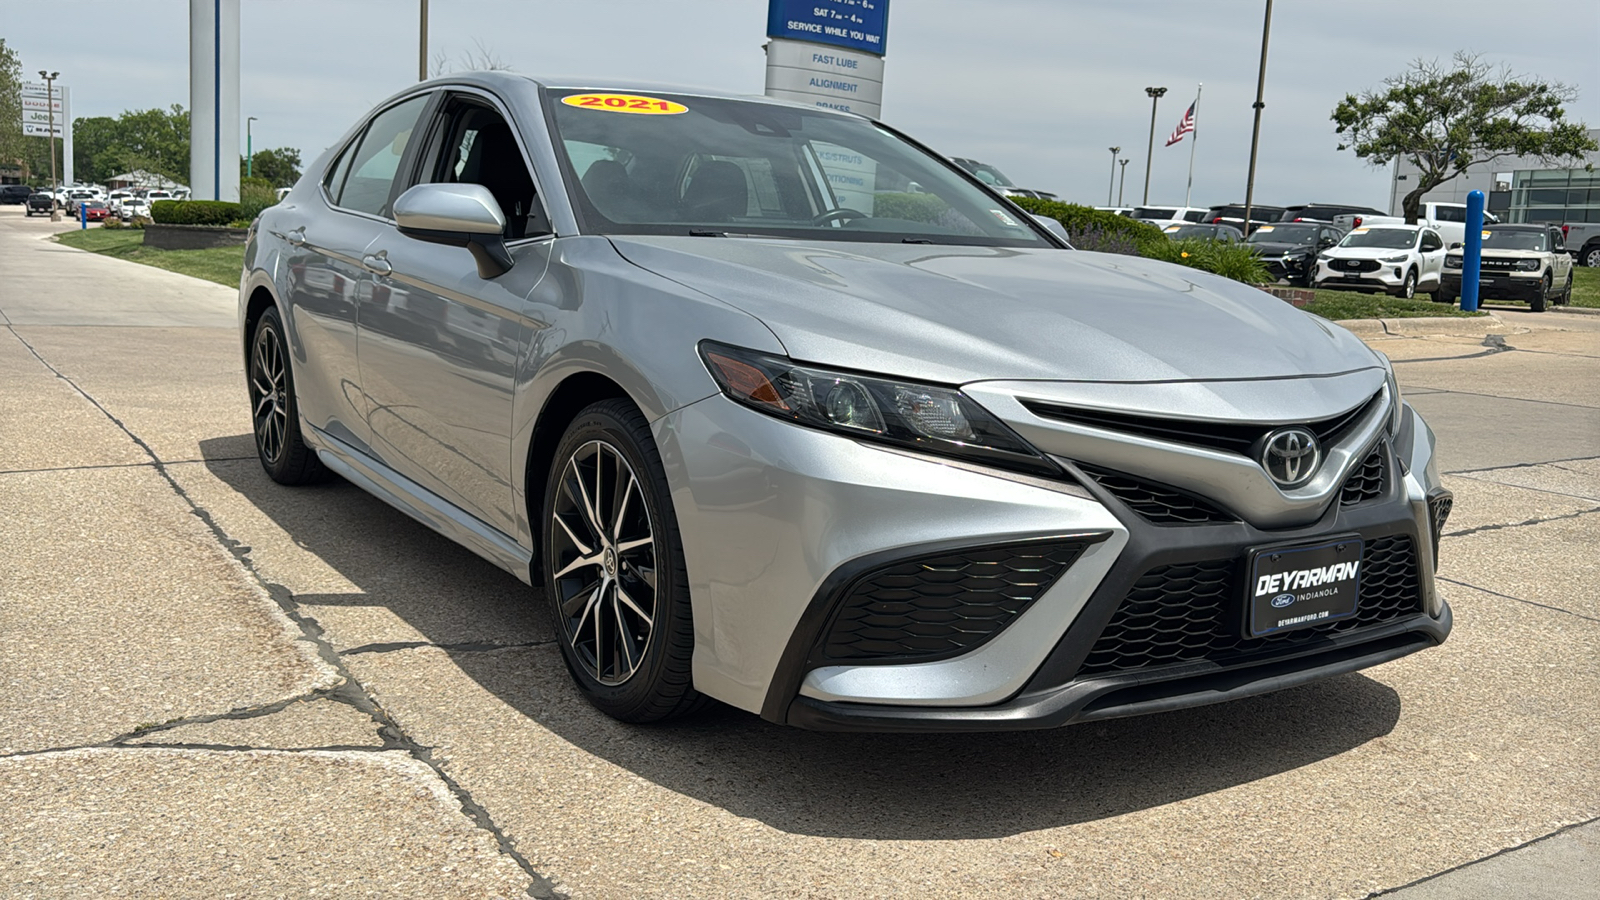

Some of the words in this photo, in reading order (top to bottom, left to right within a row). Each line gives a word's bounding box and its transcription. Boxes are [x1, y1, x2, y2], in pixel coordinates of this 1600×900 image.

[813, 7, 828, 17] SAT
[787, 20, 822, 33] SERVICE
[824, 26, 848, 38] WHILE
[850, 30, 865, 41] YOU
[866, 33, 880, 44] WAIT
[812, 54, 835, 65] FAST
[836, 57, 858, 69] LUBE
[809, 77, 858, 93] ALIGNMENT
[579, 96, 670, 111] 2021
[826, 173, 864, 186] DITIONING
[1255, 560, 1360, 597] DEYARMAN
[1296, 587, 1338, 602] INDIANOLA
[1277, 610, 1329, 627] DEYARMANFORD.COM
